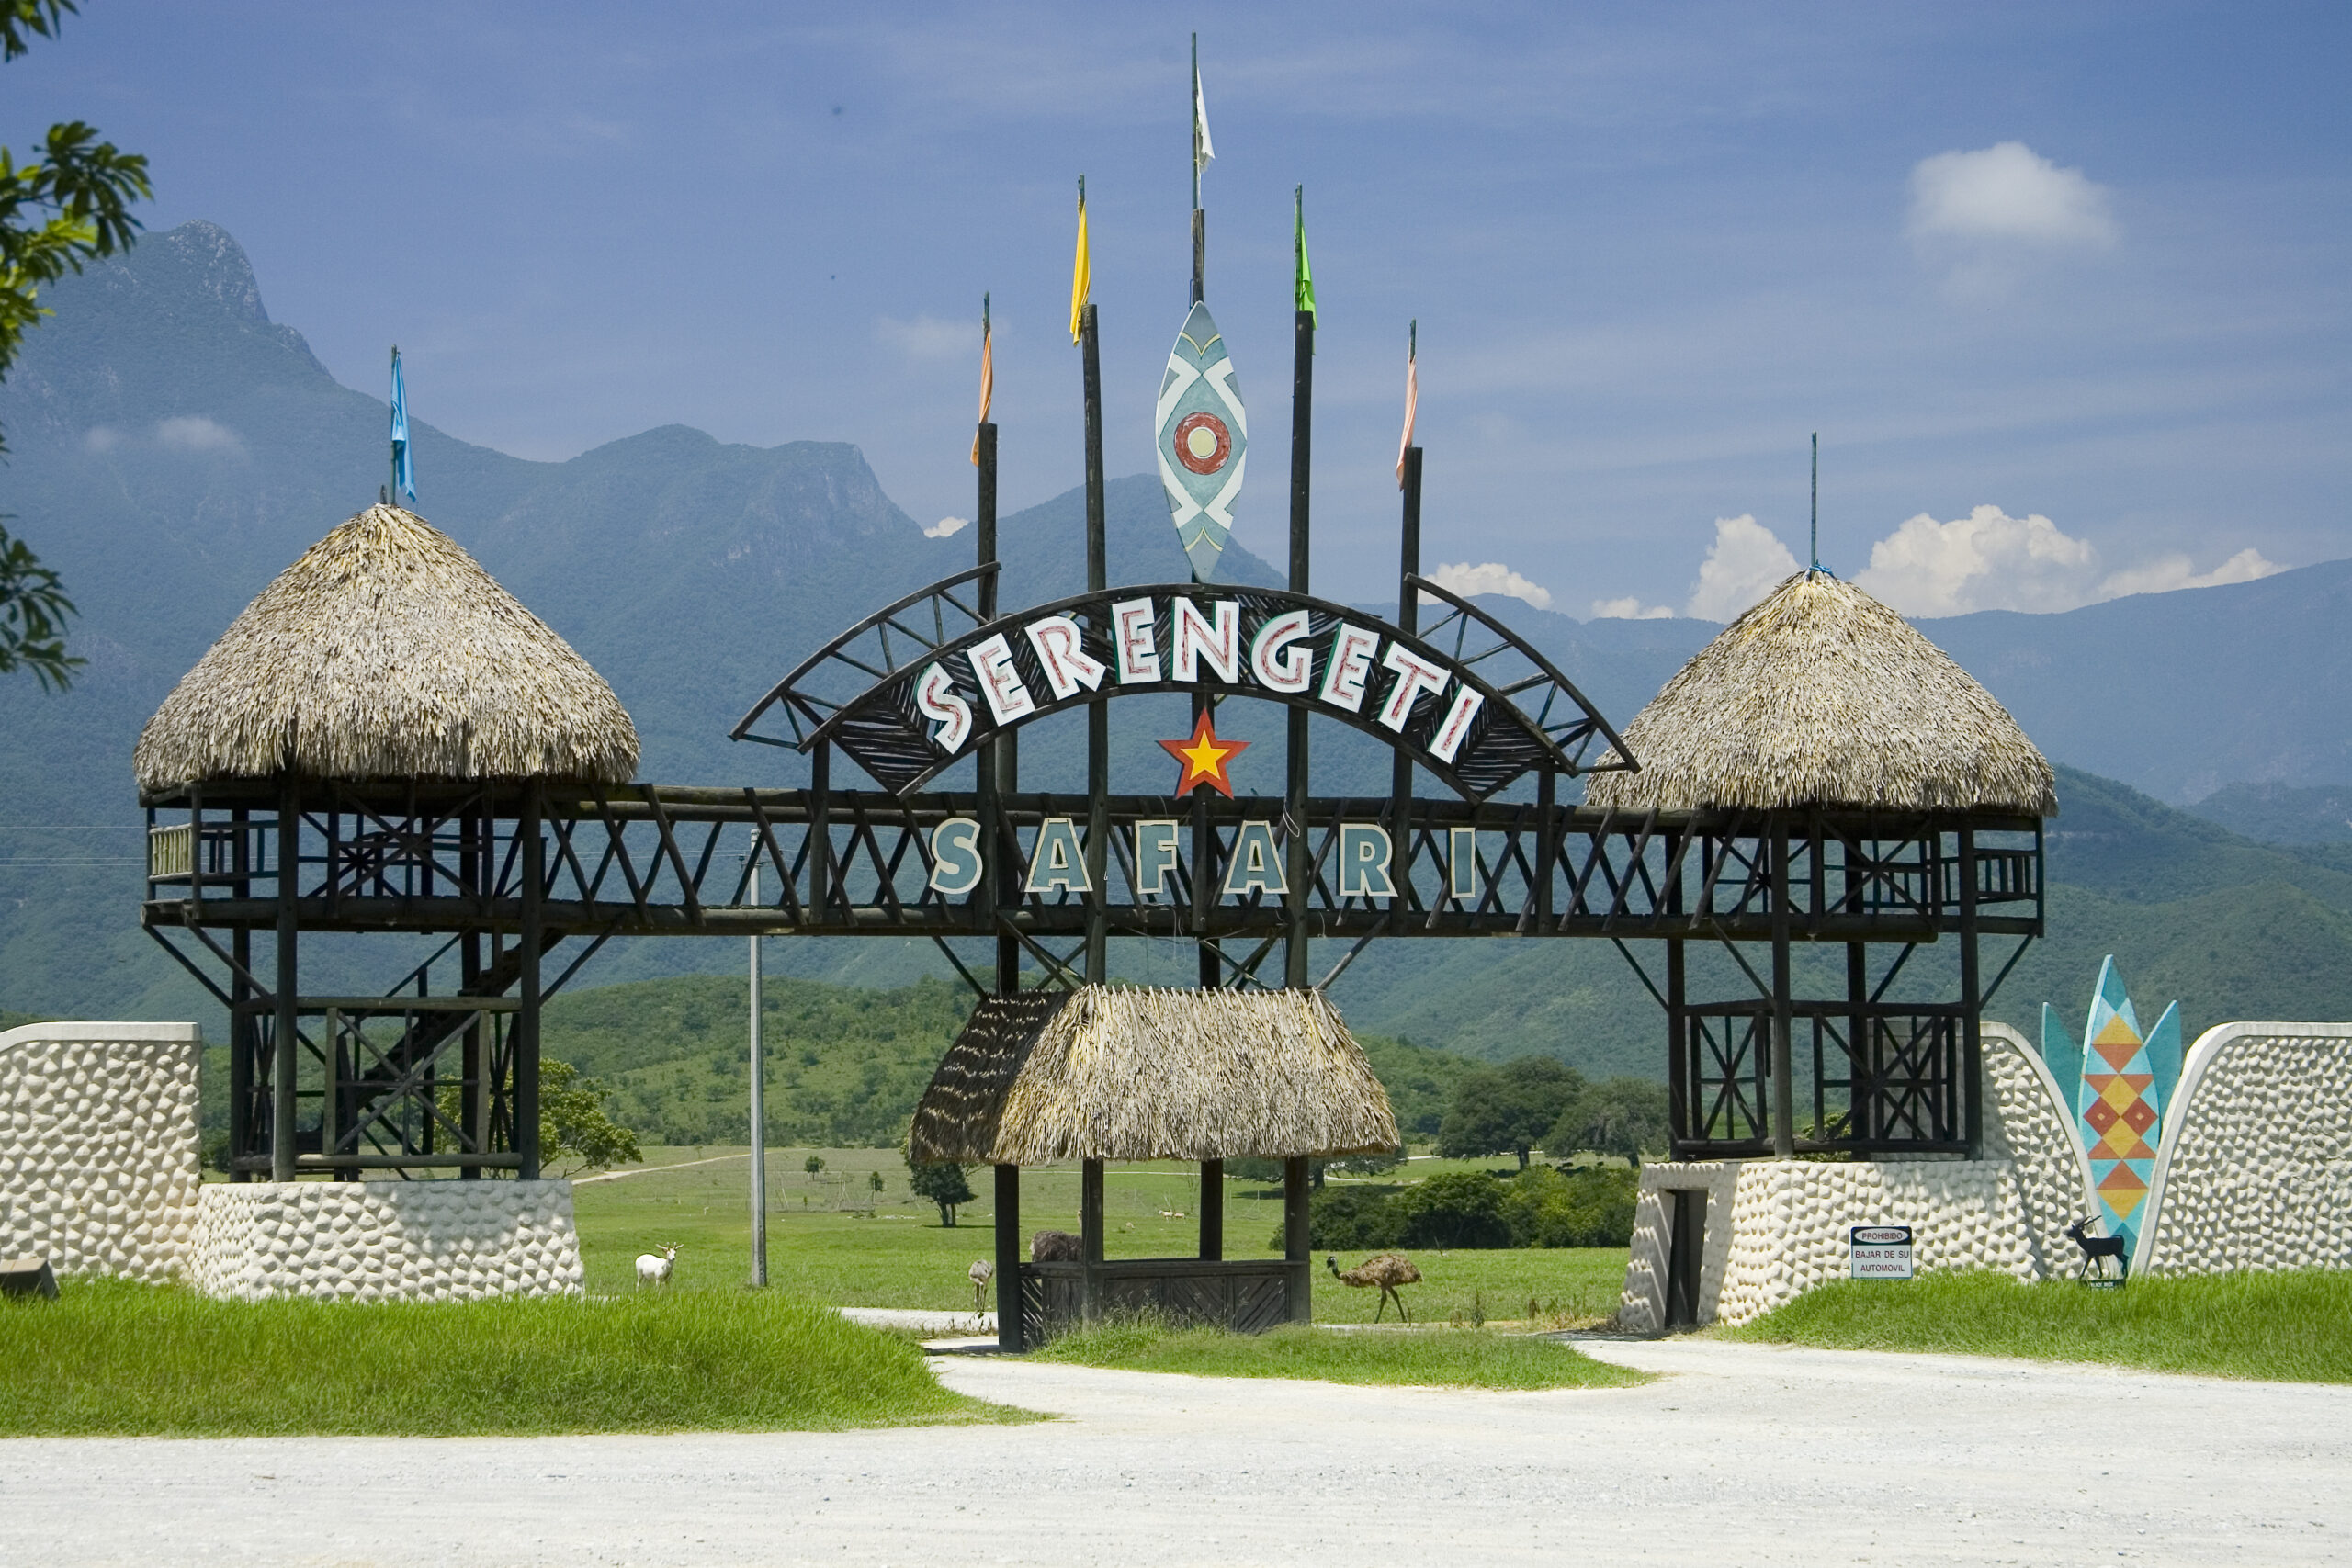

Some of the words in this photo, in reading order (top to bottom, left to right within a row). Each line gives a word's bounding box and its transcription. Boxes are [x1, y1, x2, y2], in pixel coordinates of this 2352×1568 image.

[916, 596, 1485, 764] SERENGETI
[928, 817, 1476, 899] SAFARI
[1861, 1232, 1903, 1240] PROHIBIDO
[1855, 1250, 1881, 1258] BAJAR
[1884, 1250, 1894, 1258] DE
[1898, 1250, 1909, 1258] SU
[1860, 1264, 1905, 1272] AUTOMOVIL
